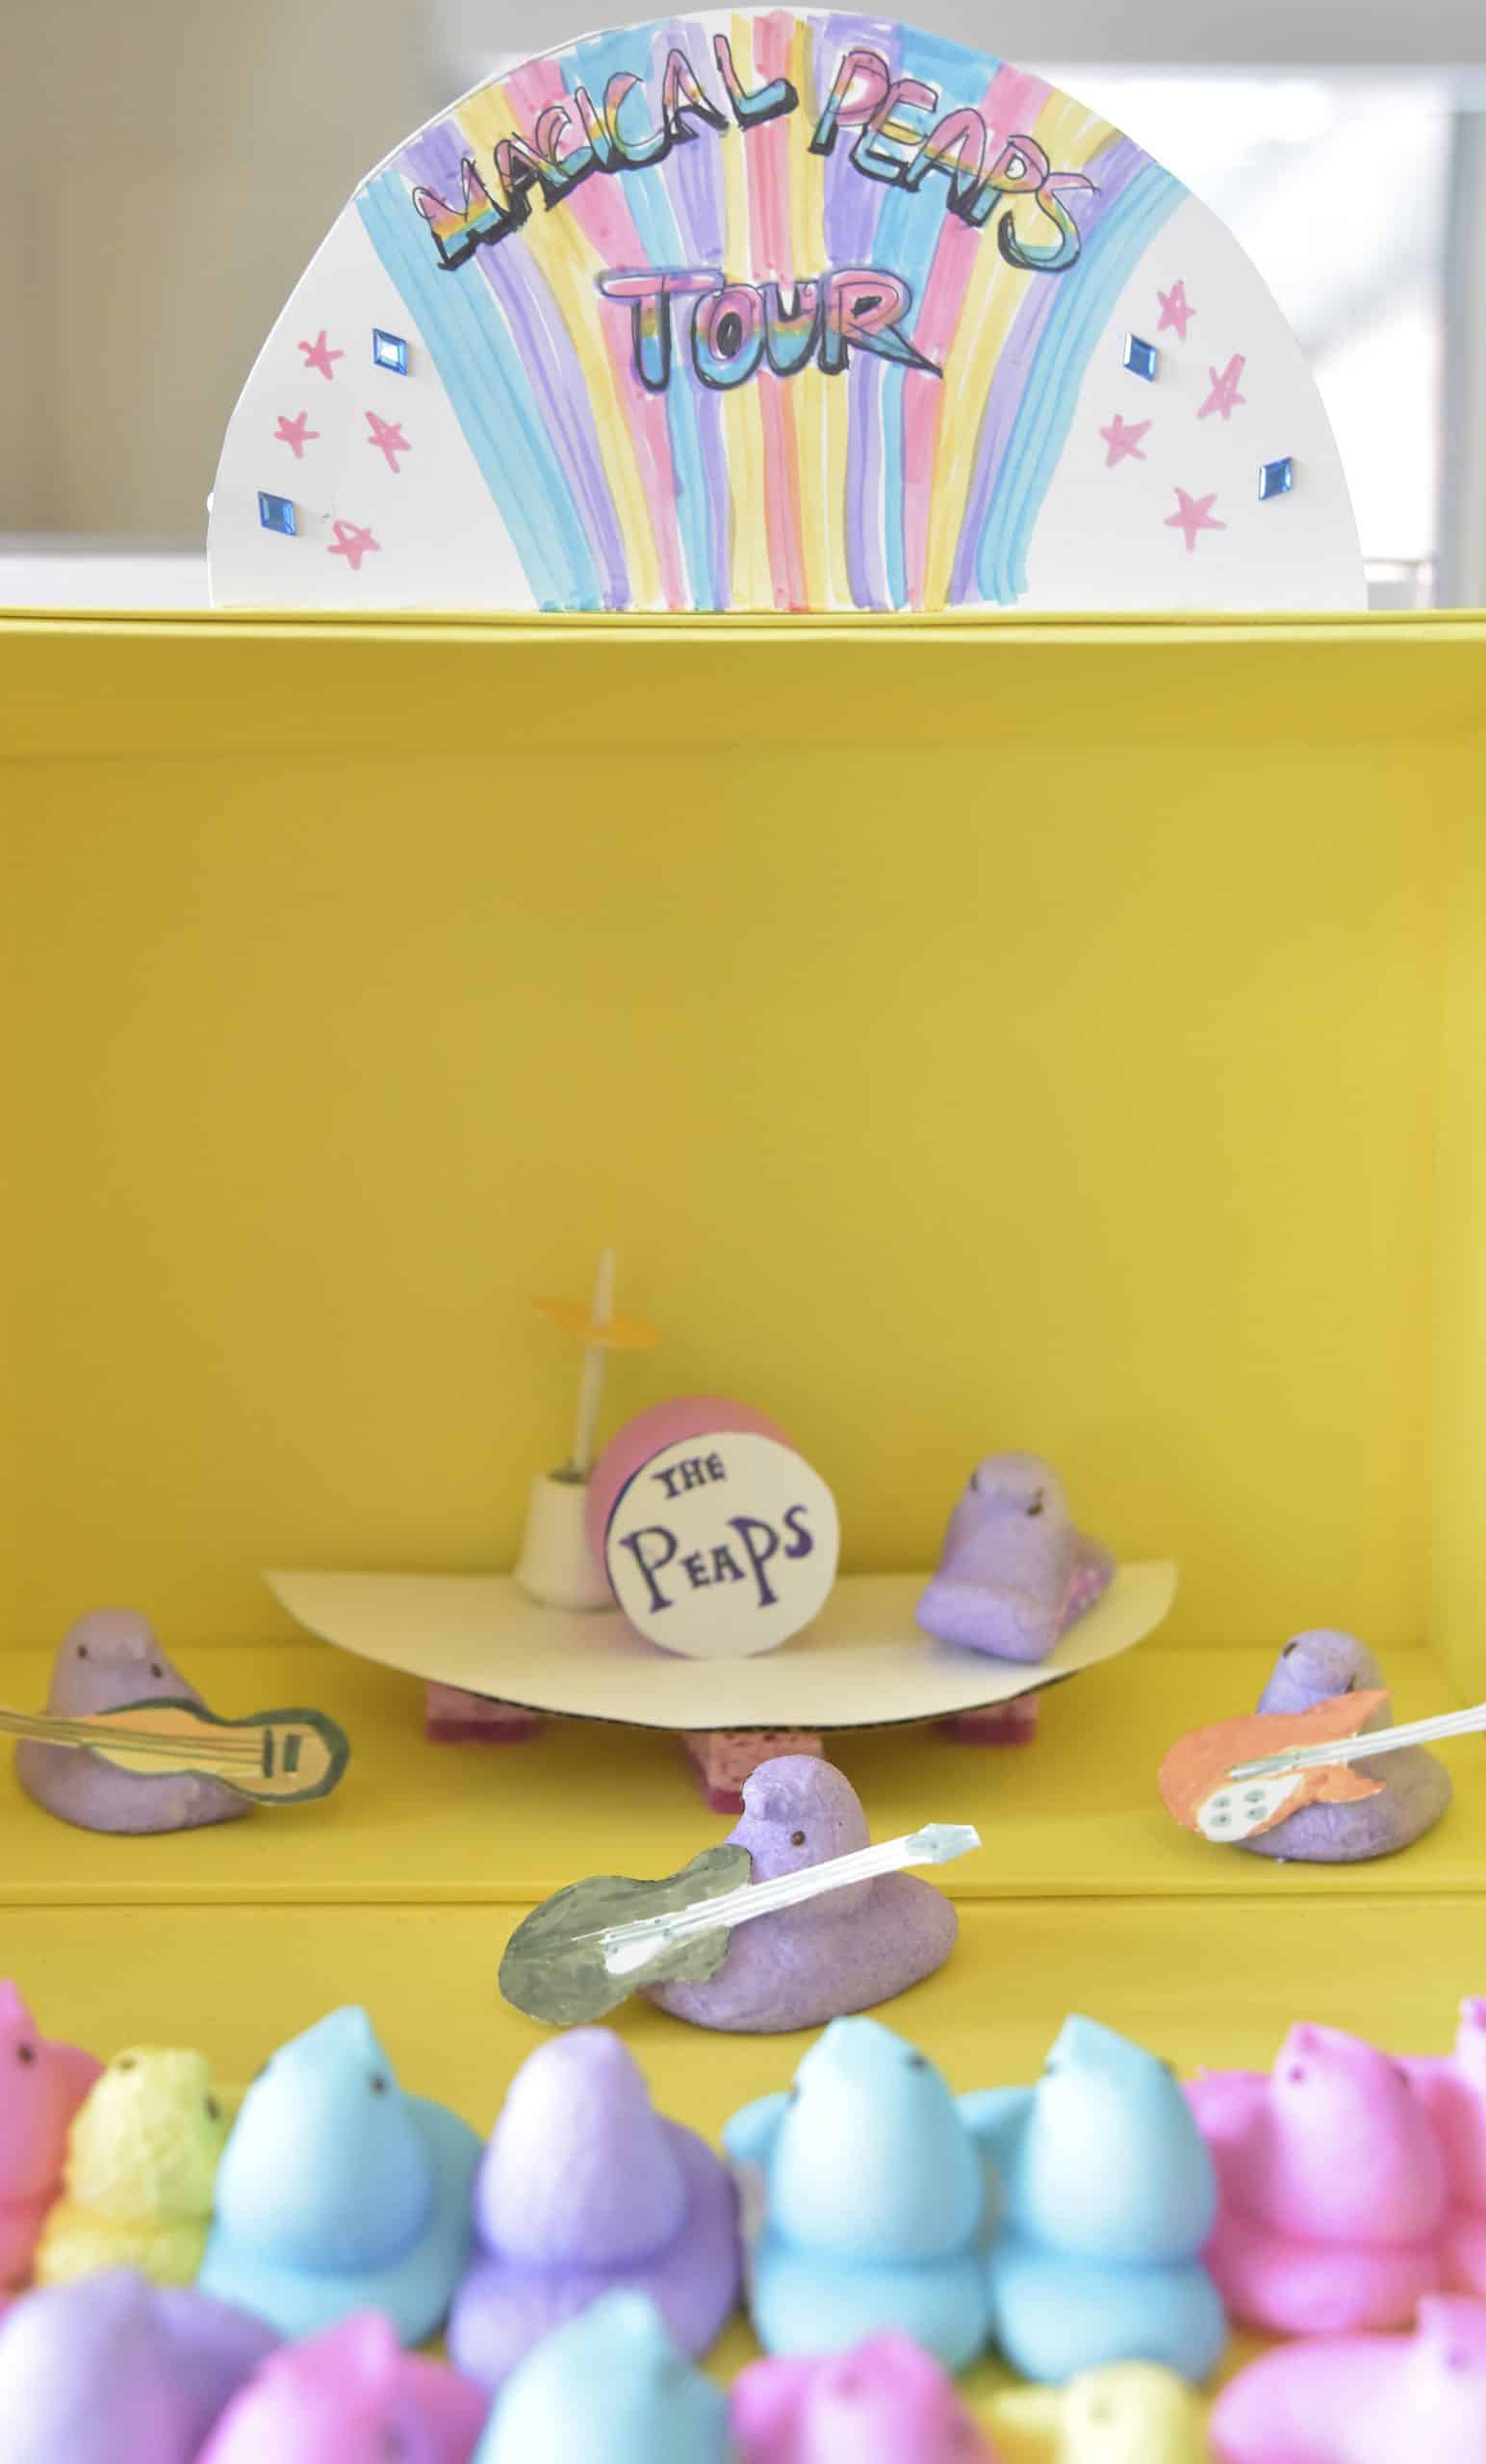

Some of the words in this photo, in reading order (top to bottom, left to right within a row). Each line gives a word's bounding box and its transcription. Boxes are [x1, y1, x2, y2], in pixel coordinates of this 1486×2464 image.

[412, 34, 800, 270] MAGICAL
[808, 48, 1101, 271] PEAPS
[597, 268, 943, 392] TOUR
[651, 1451, 726, 1499] THE
[619, 1503, 814, 1614] PEAPS
